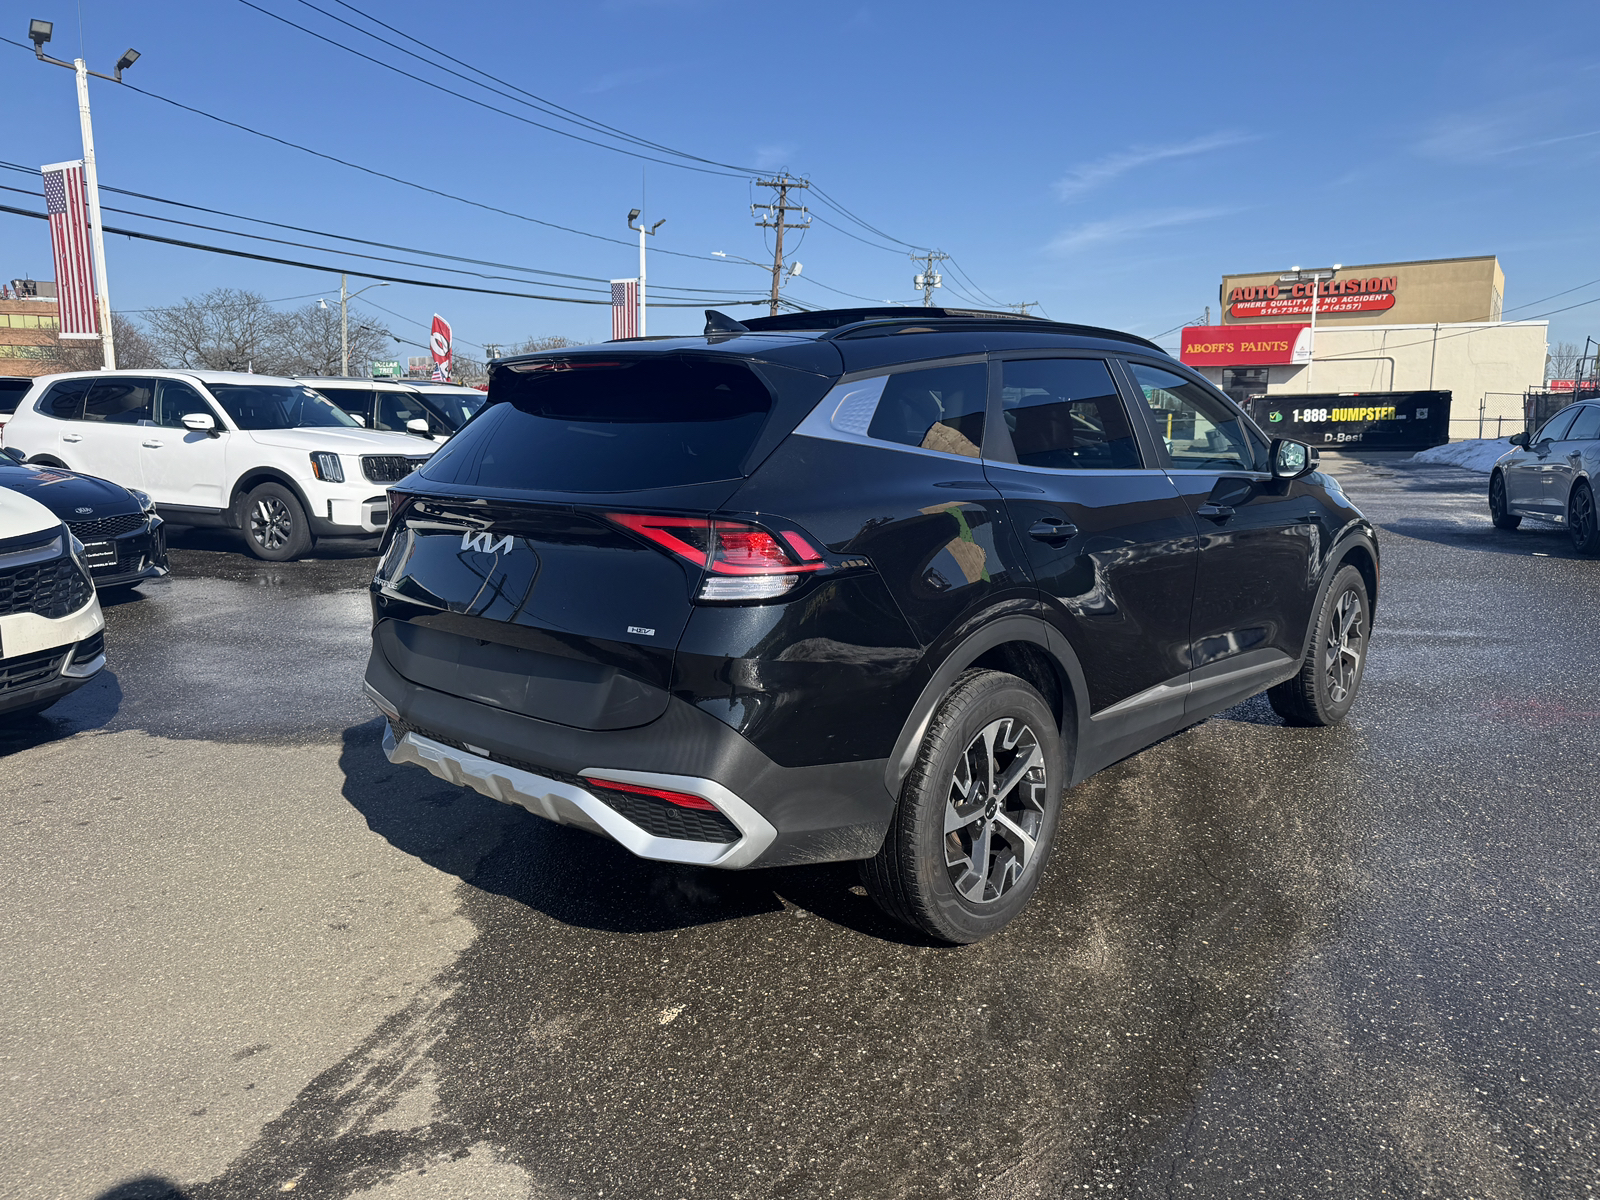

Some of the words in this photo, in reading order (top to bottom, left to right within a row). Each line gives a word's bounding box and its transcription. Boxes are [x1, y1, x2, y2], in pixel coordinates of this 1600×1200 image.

[1231, 284, 1280, 300] AUTO
[1292, 276, 1398, 297] COLLISION
[1270, 299, 1308, 307] QUALITY
[1325, 296, 1338, 304] NO
[1341, 294, 1388, 302] ACCIDENT
[1330, 303, 1362, 311] (4357)
[1185, 342, 1234, 354] ABOFF'S
[1240, 341, 1289, 352] PAINTS
[1324, 433, 1363, 443] D-Best
[460, 530, 514, 556] KIA
